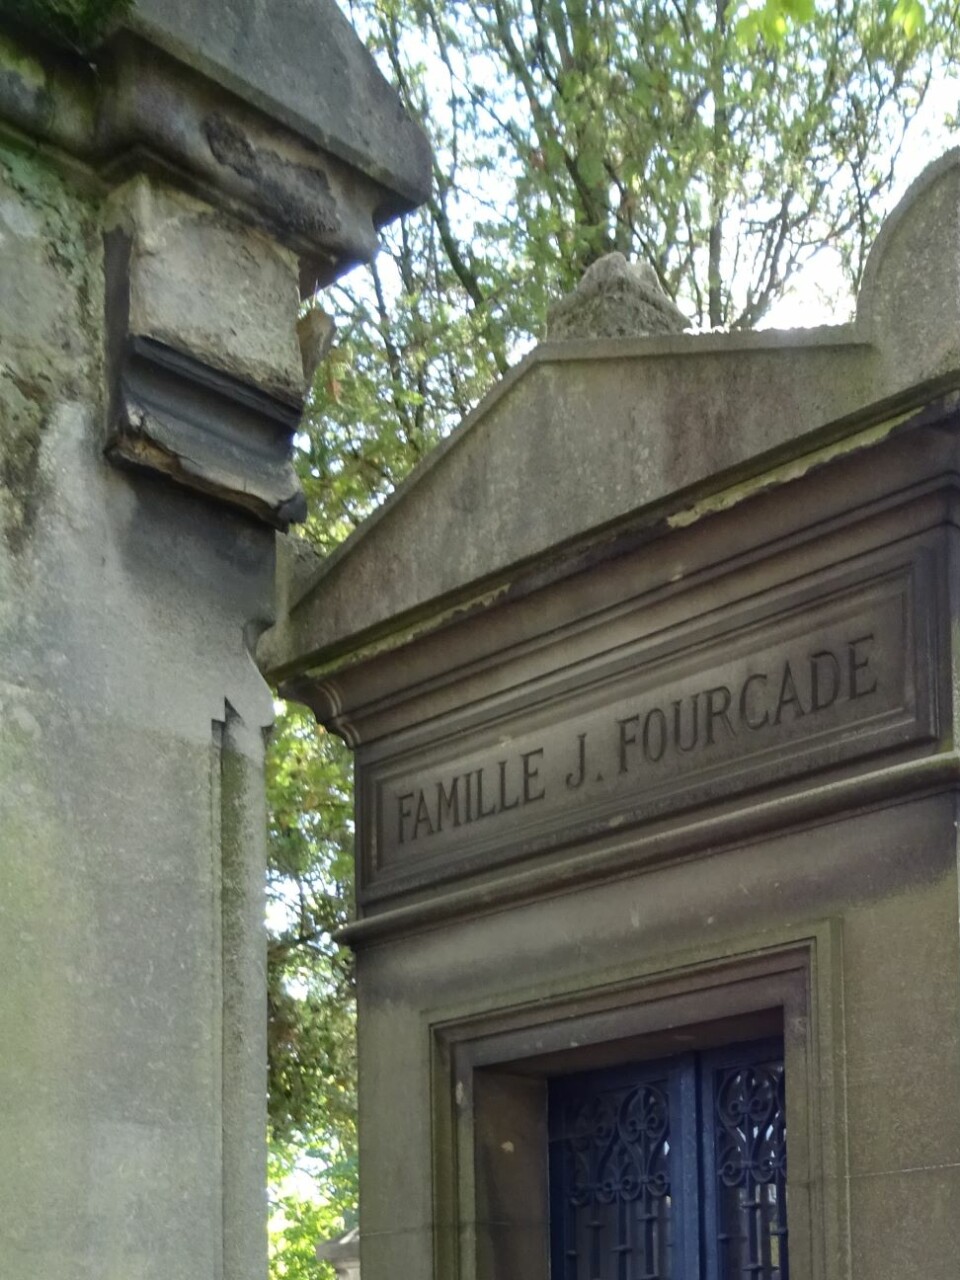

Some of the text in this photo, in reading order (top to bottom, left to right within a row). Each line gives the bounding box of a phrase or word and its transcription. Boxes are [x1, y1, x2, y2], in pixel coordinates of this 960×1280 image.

[397, 632, 879, 846] FAMILLE J. FOURCADE
